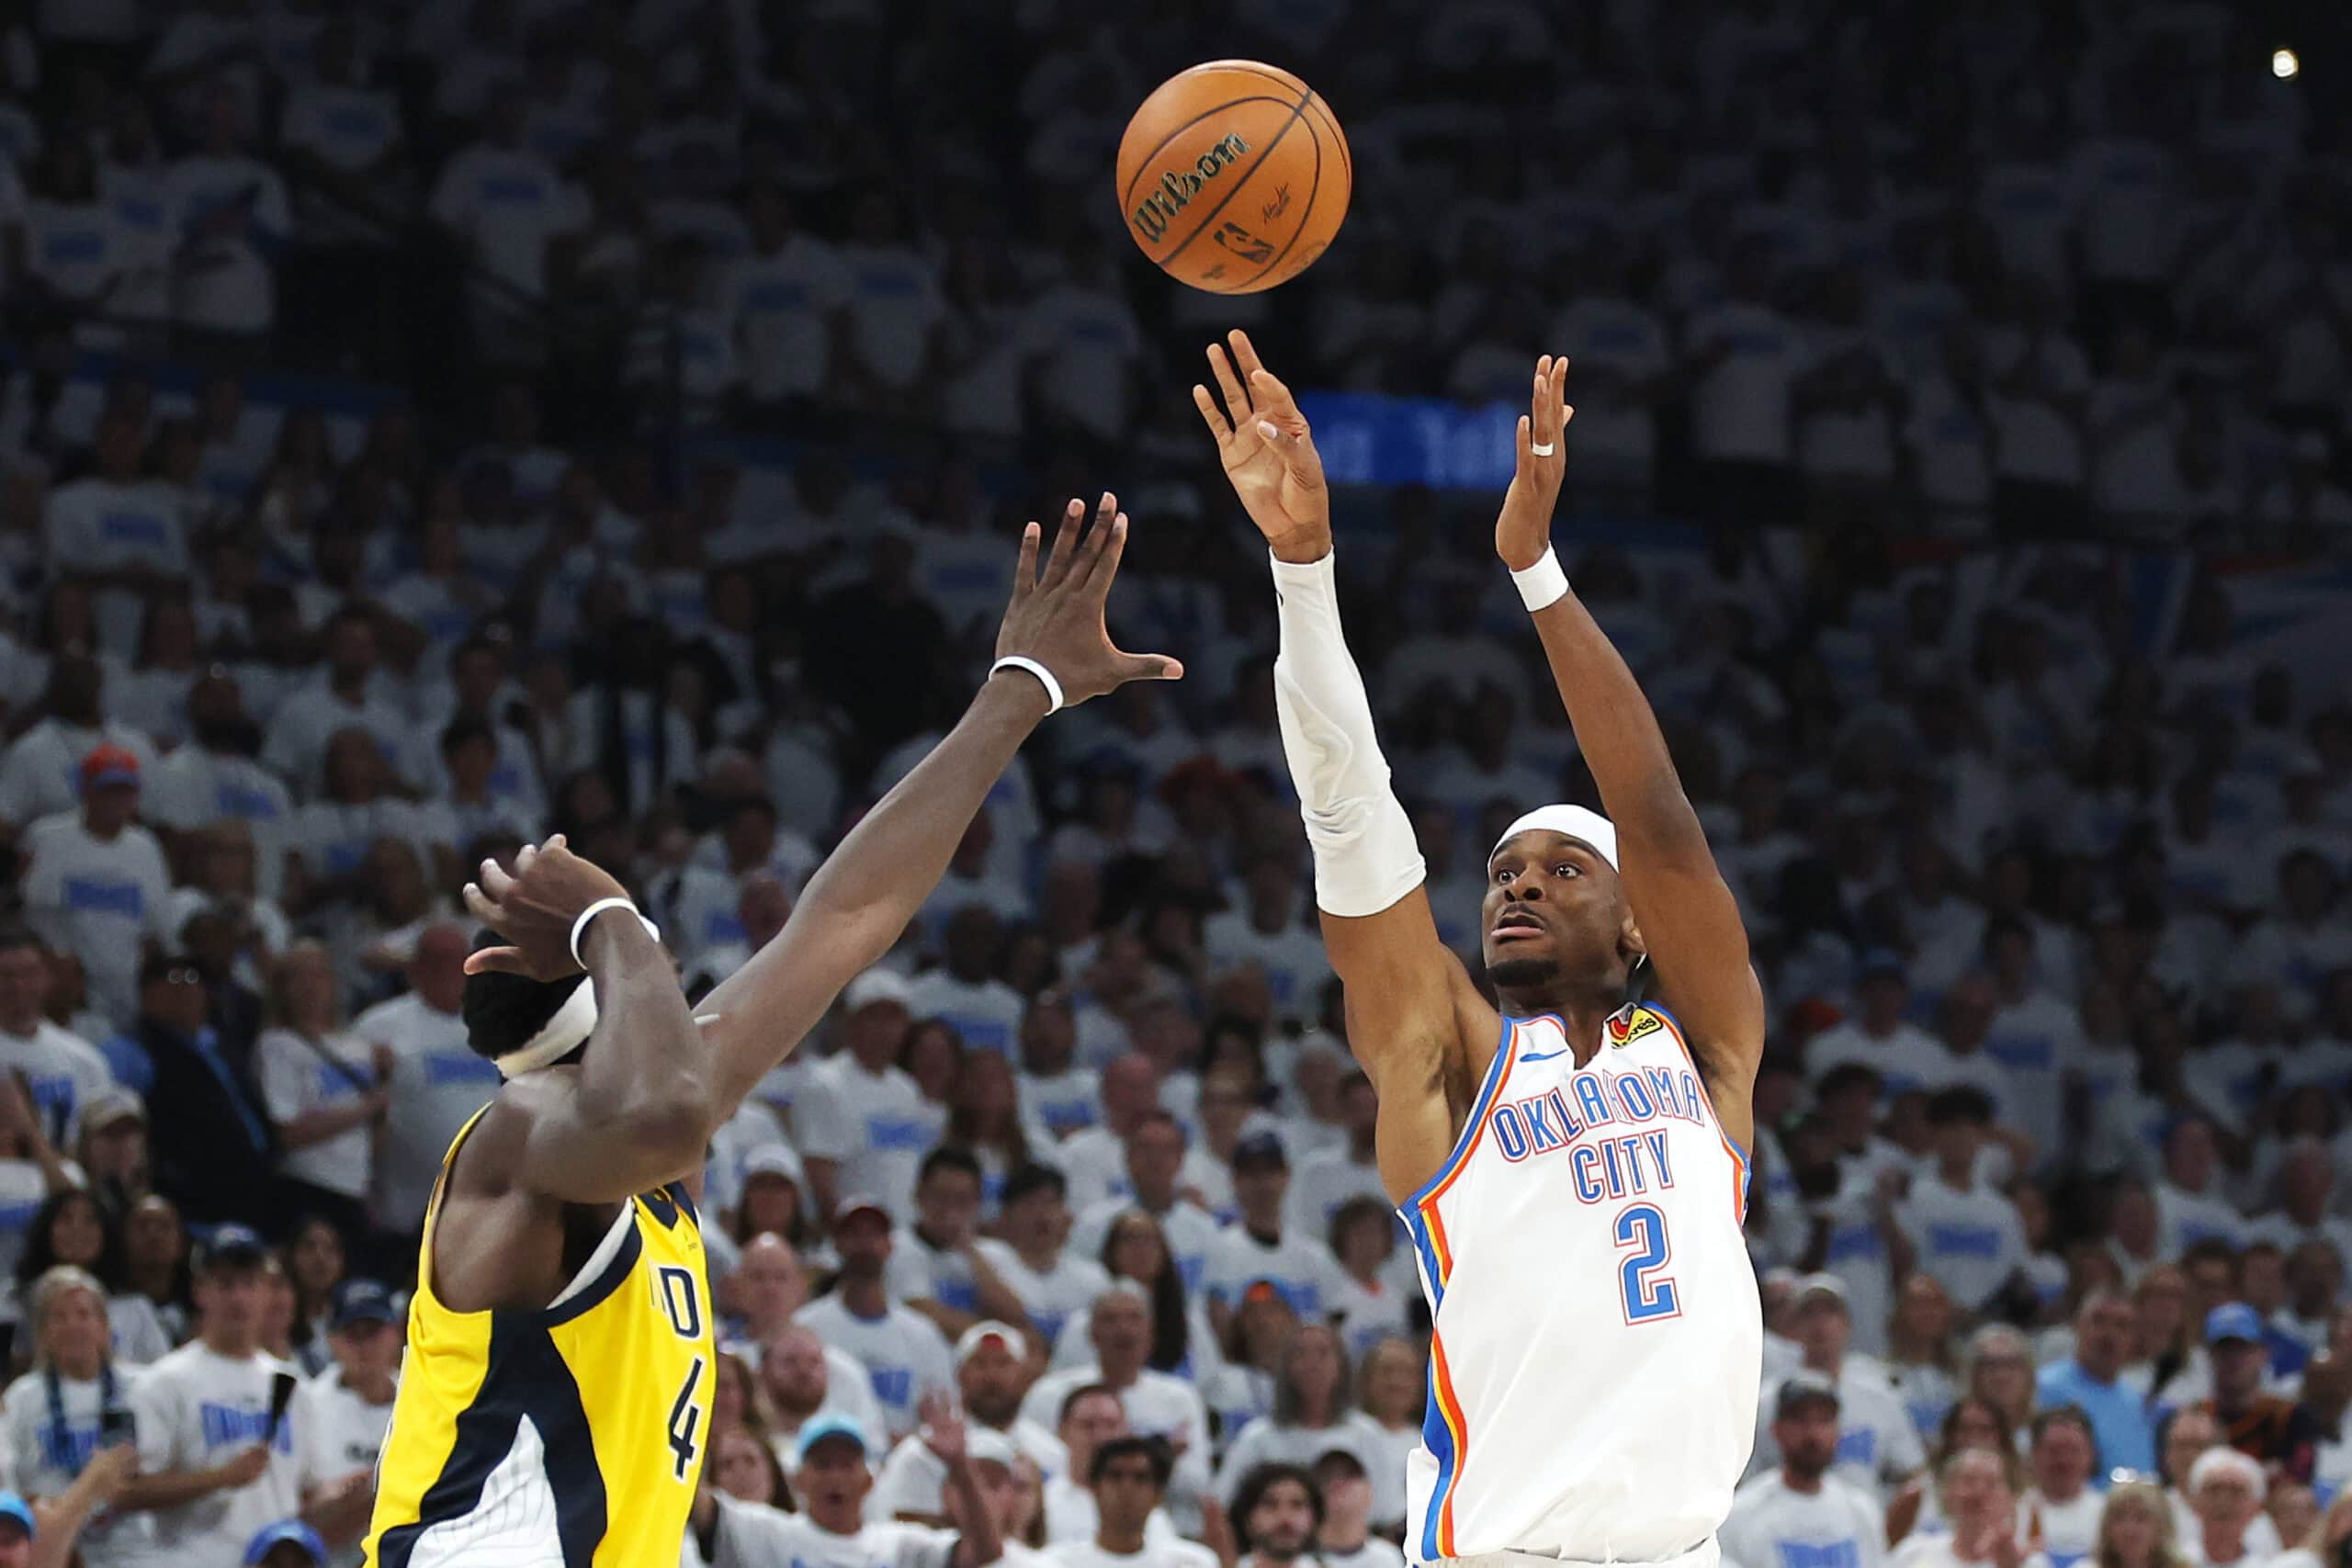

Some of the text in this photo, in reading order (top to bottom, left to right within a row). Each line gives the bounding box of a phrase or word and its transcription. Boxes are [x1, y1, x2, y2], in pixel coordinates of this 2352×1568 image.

[1133, 132, 1251, 244] Wilson
[1568, 1128, 1675, 1205] CITY
[1612, 1201, 1683, 1327] 2
